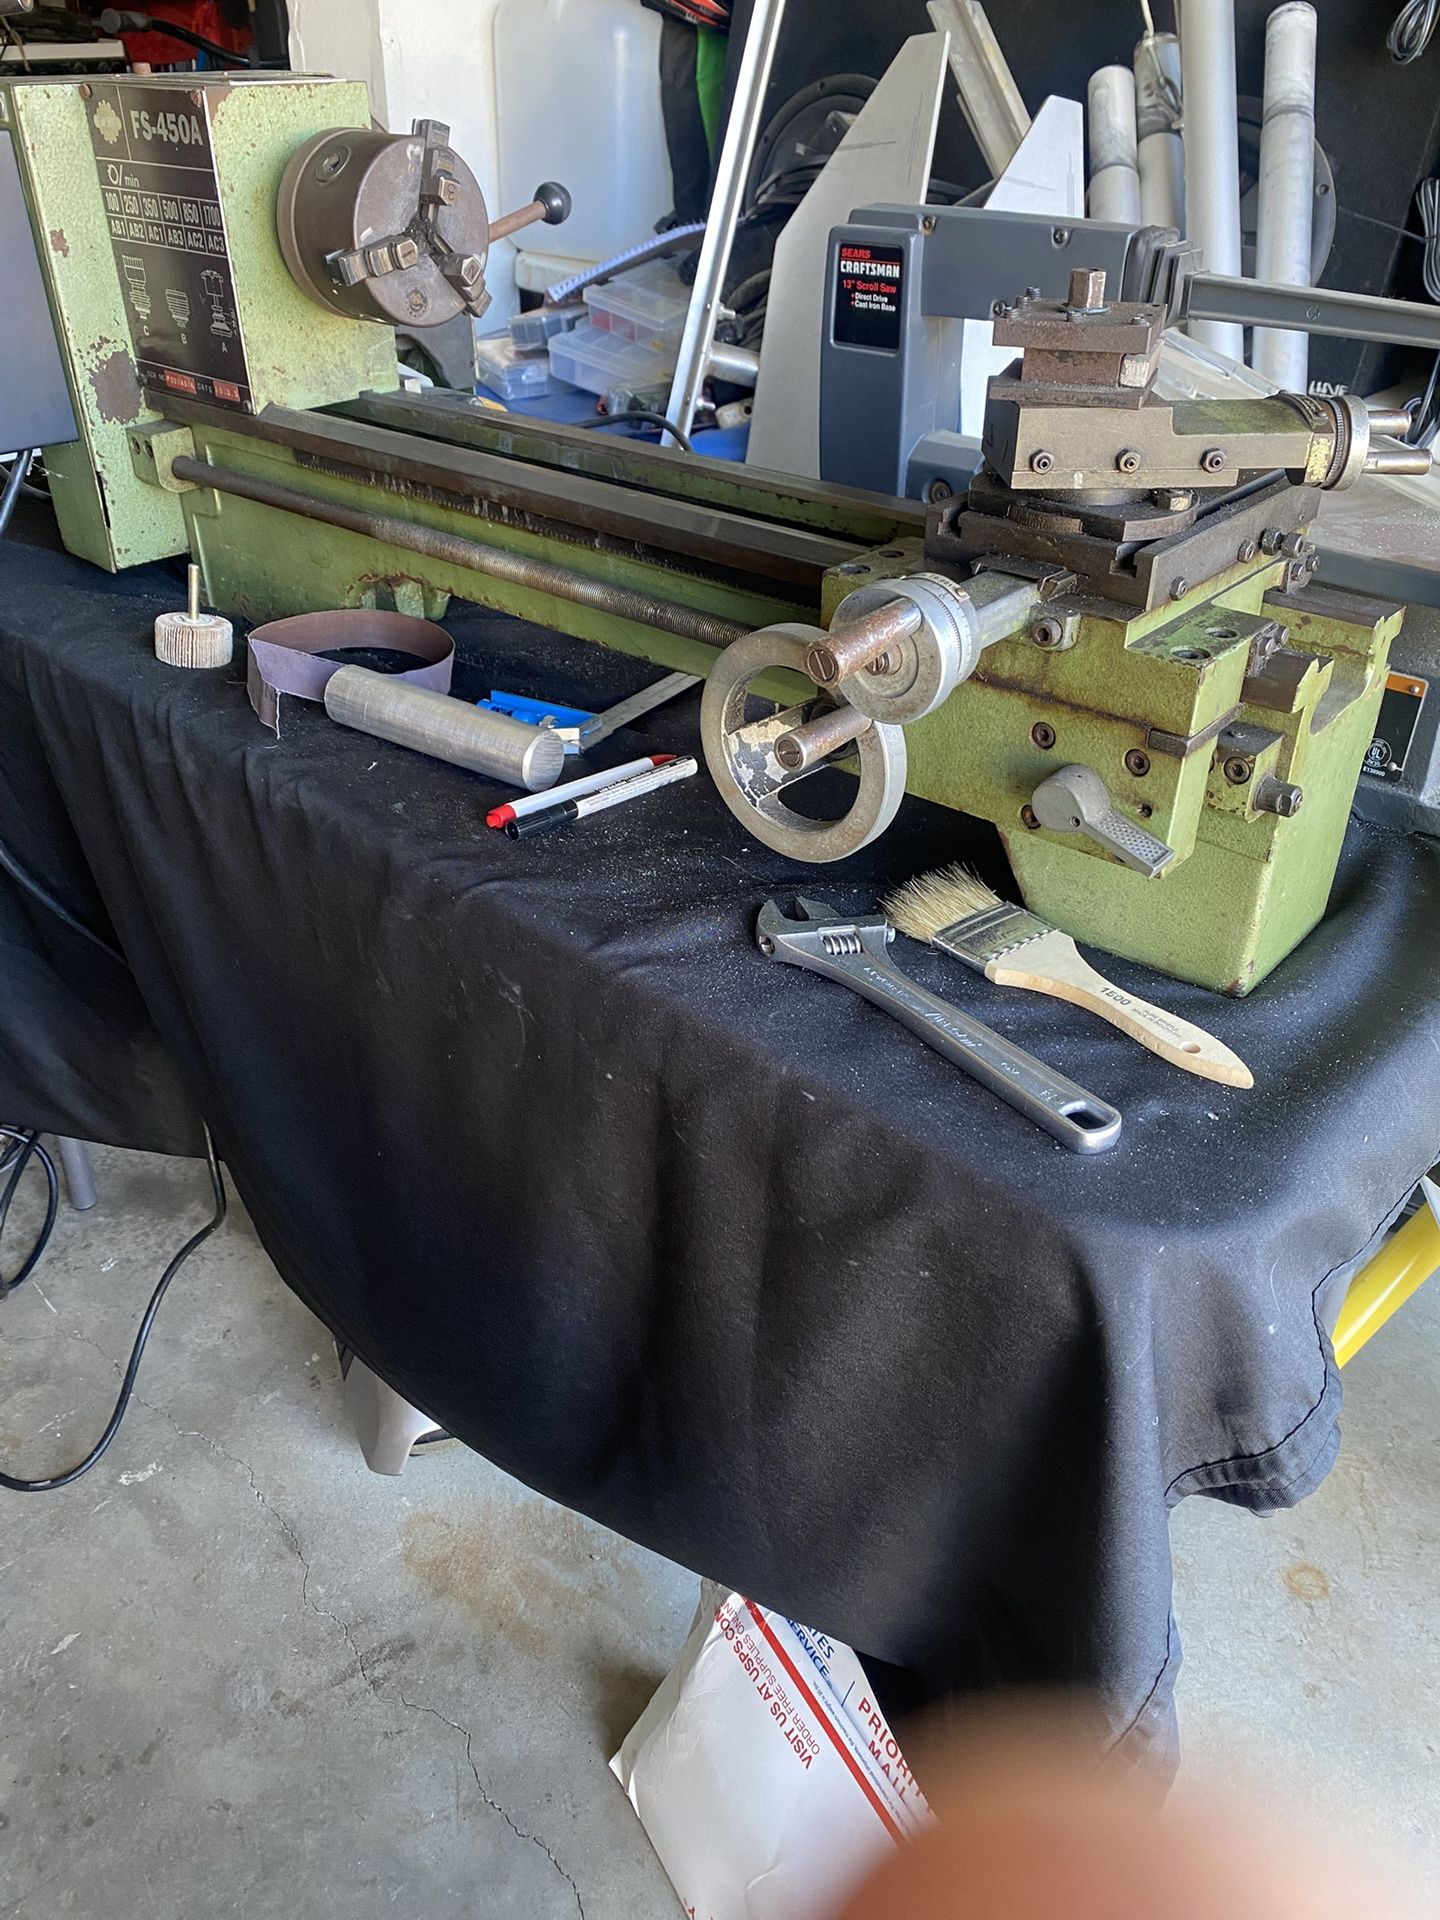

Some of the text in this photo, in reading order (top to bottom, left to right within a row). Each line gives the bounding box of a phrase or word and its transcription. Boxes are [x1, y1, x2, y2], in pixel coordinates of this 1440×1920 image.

[130, 110, 203, 145] FS-450A
[105, 191, 221, 226] 100 250 350 500 850 1700
[111, 219, 225, 252] AB1 AB2 AC1 AB3 AC2 AC3
[841, 247, 871, 259] SEARS
[840, 261, 900, 278] CRAFTSMAN
[843, 279, 896, 294] 13" Scroll Saw
[854, 291, 888, 303] Direct Drive
[854, 299, 896, 312] Cast Iron Base
[143, 325, 149, 336] C
[181, 333, 187, 344] B
[221, 342, 227, 353] A
[1100, 987, 1131, 1006] 1500
[788, 1620, 830, 1677] ERVICE
[743, 1634, 776, 1686] SUPPLIES
[756, 1682, 773, 1701] AT
[773, 1684, 795, 1715] FREE
[770, 1701, 787, 1728] US
[792, 1713, 820, 1755] ORDER
[784, 1729, 813, 1770] VISIT
